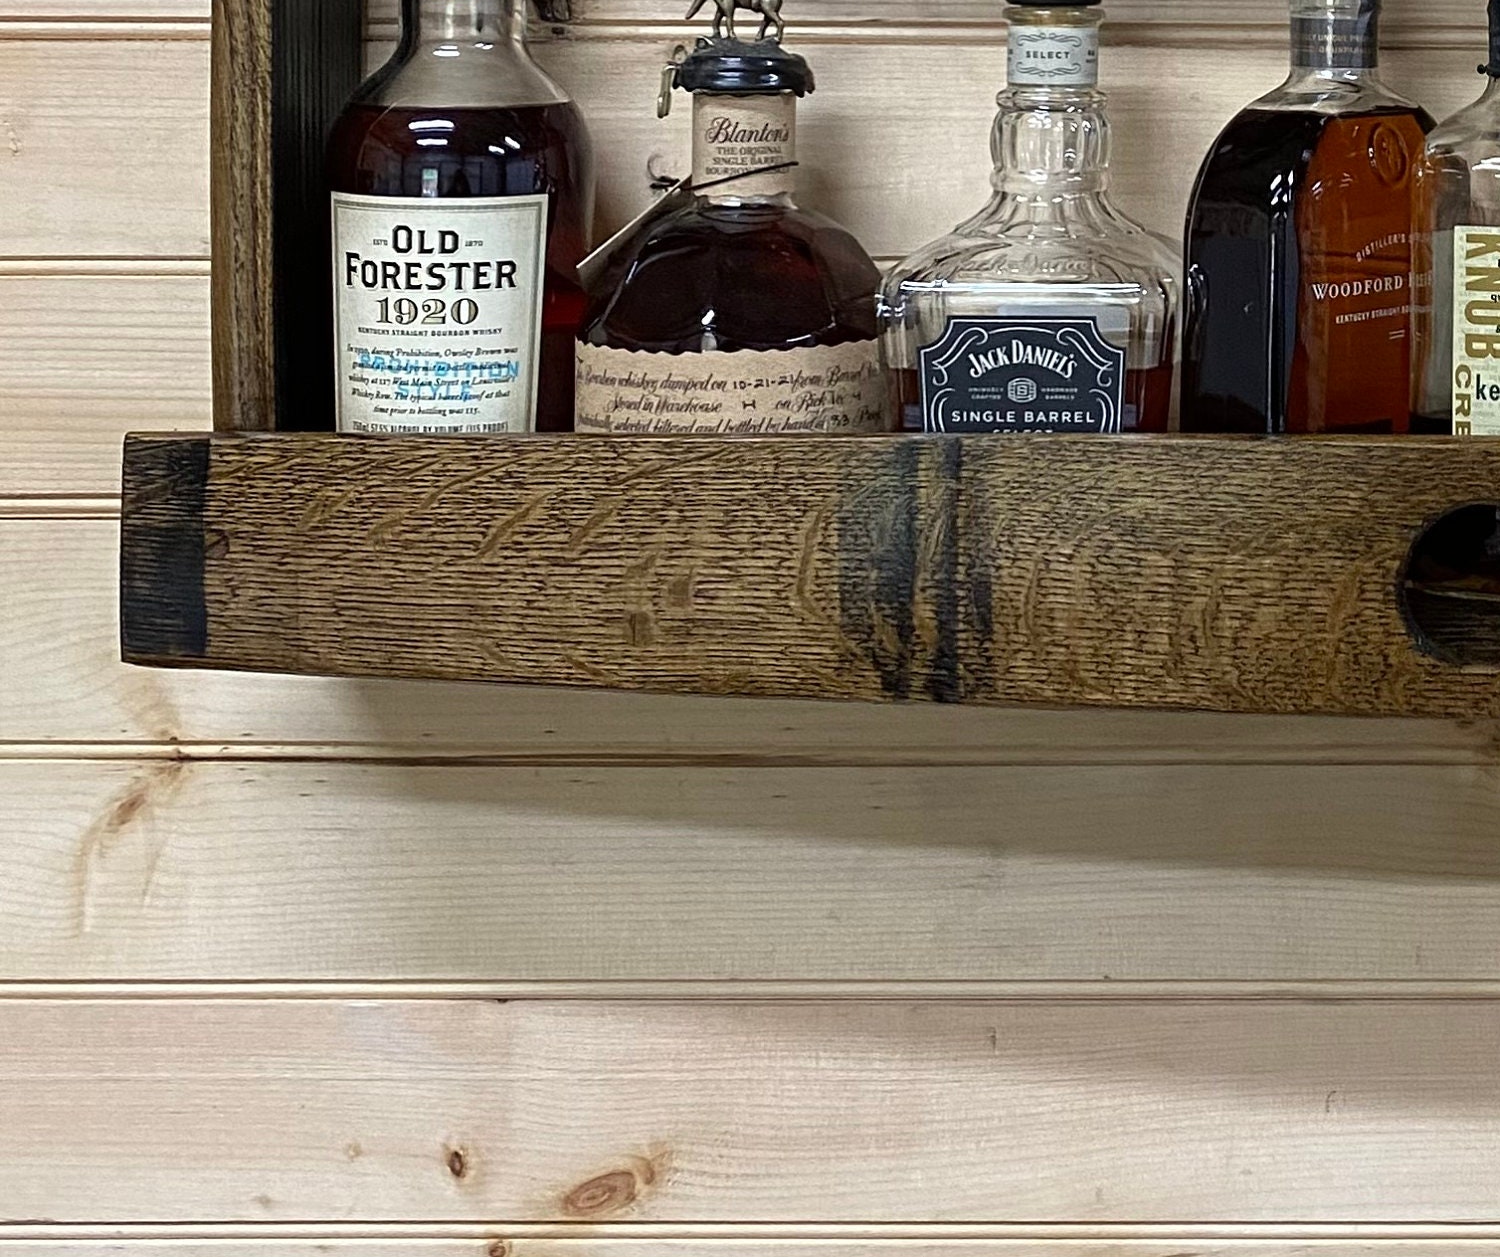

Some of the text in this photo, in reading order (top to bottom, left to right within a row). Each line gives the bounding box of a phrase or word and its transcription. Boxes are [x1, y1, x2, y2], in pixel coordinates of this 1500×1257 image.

[1025, 50, 1070, 59] SELECT
[392, 224, 460, 254] OLD
[1356, 233, 1406, 263] DISTILLER'S
[345, 251, 518, 290] FORESTER
[1312, 275, 1404, 301] WOODFORD
[376, 296, 480, 326] 1920
[1335, 312, 1370, 324] KENTUCKY
[358, 327, 503, 337] KENTUCKY STRAIGHT BOURBON WHISKY
[968, 339, 1078, 379] JACK DANIEL'S
[733, 373, 794, 389] 10-21-21
[951, 410, 1095, 423] SINGLE BARREL
